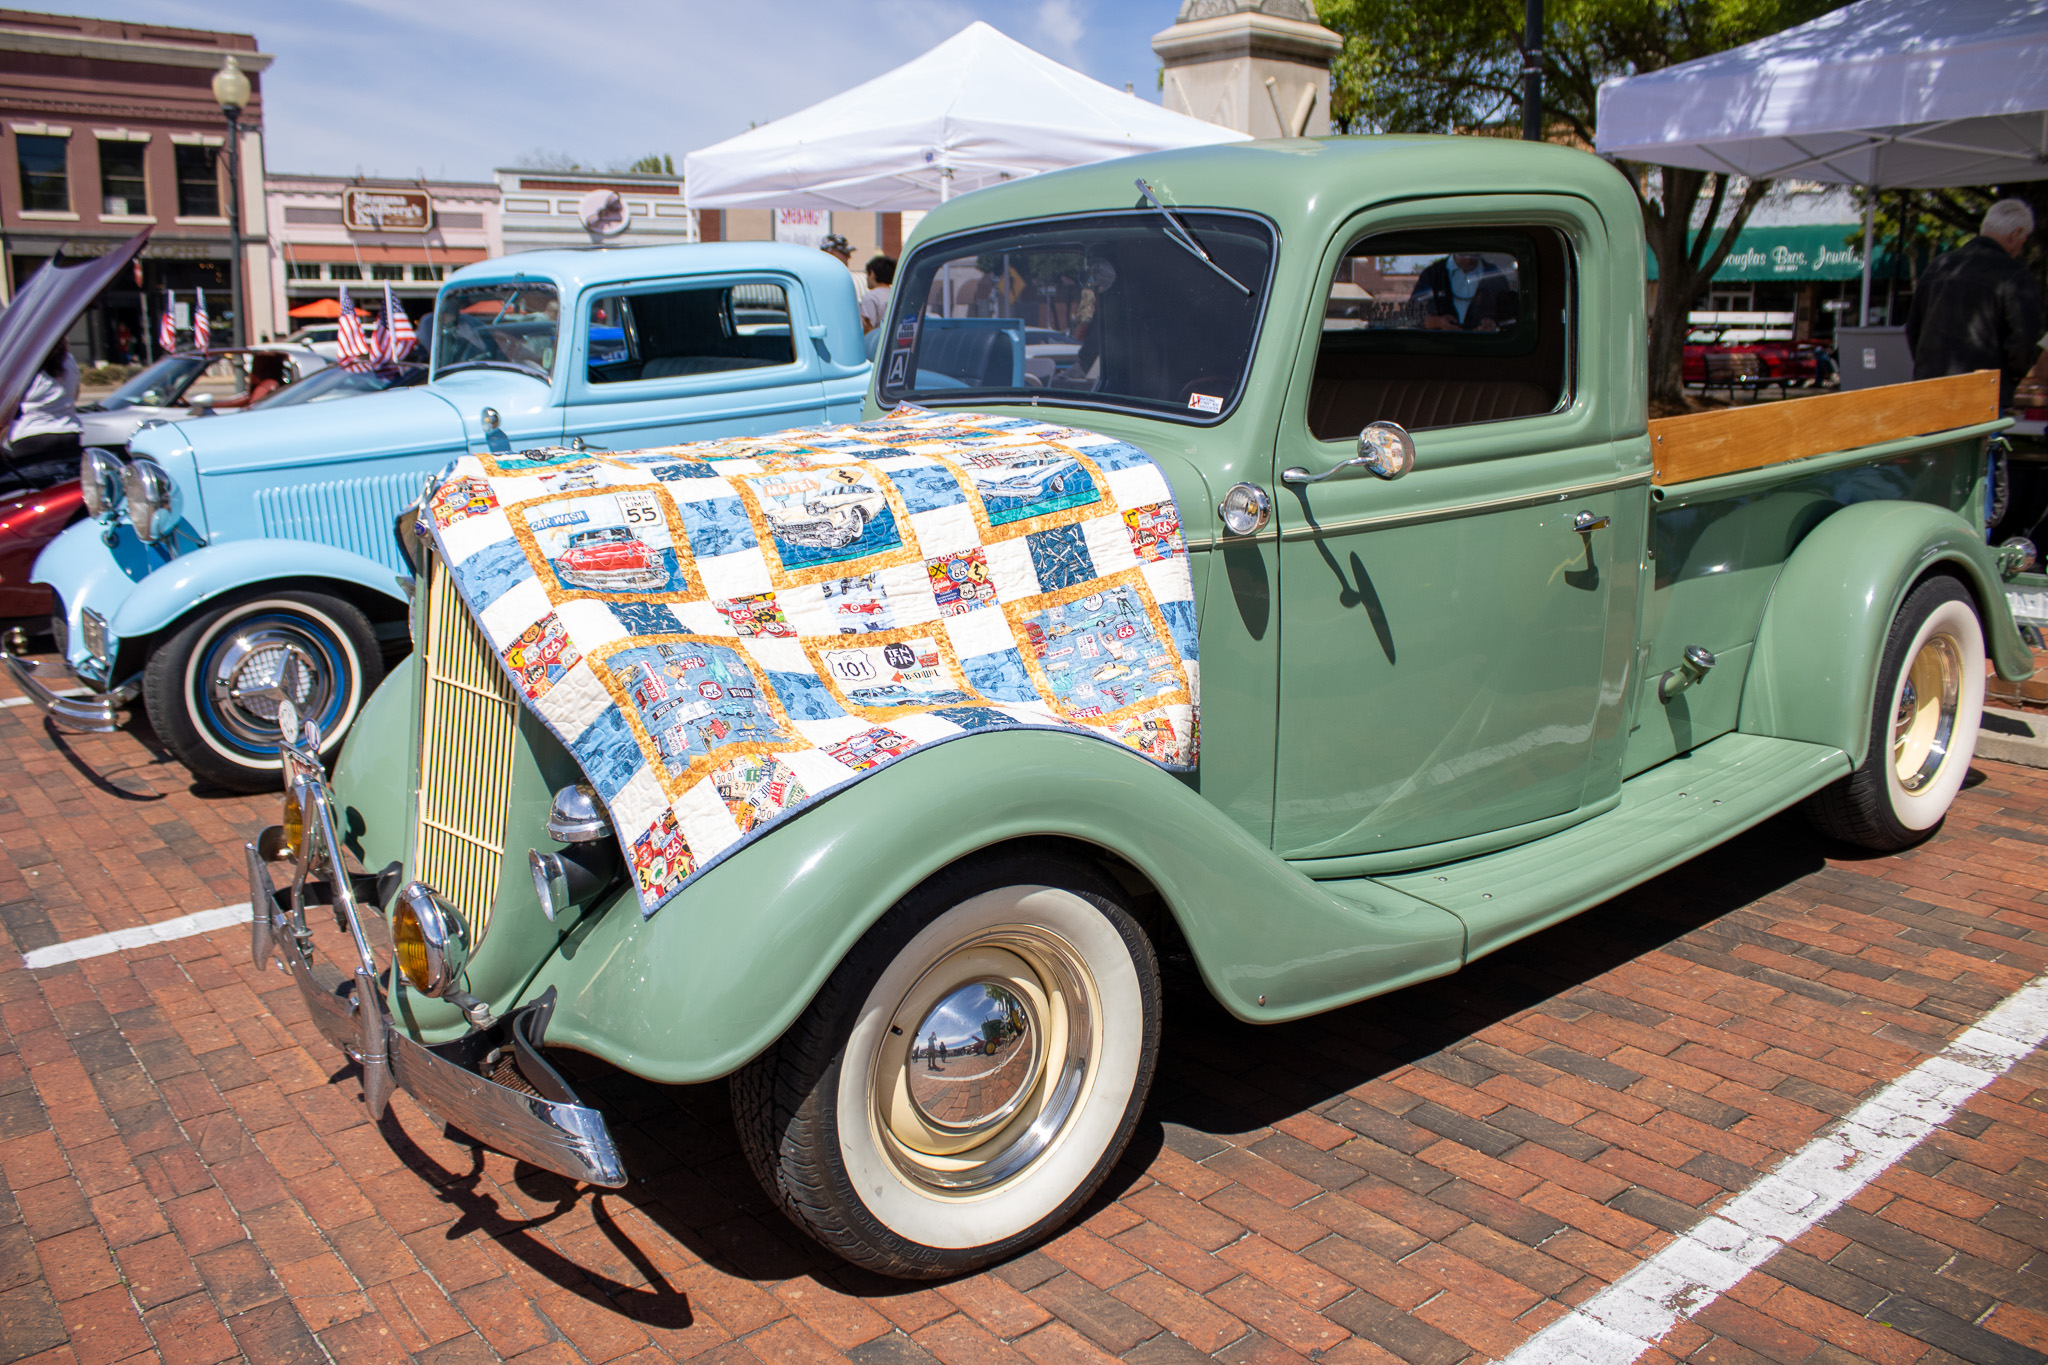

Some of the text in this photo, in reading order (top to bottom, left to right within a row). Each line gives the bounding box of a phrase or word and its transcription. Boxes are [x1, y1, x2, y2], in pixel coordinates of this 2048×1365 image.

[1723, 246, 1767, 272] ouglas
[890, 355, 903, 380] A
[766, 479, 815, 495] MOTEL
[625, 500, 650, 508] LIMIT
[530, 510, 585, 531] CAR WASH
[627, 507, 657, 523] 55
[1157, 522, 1171, 533] 66
[732, 610, 751, 620] 66
[1119, 627, 1133, 638] 66
[544, 640, 561, 658] 66
[885, 646, 911, 657] TEN
[889, 655, 915, 666] PIN
[838, 661, 870, 677] 101
[705, 689, 719, 697] 66
[665, 840, 681, 859] 66
